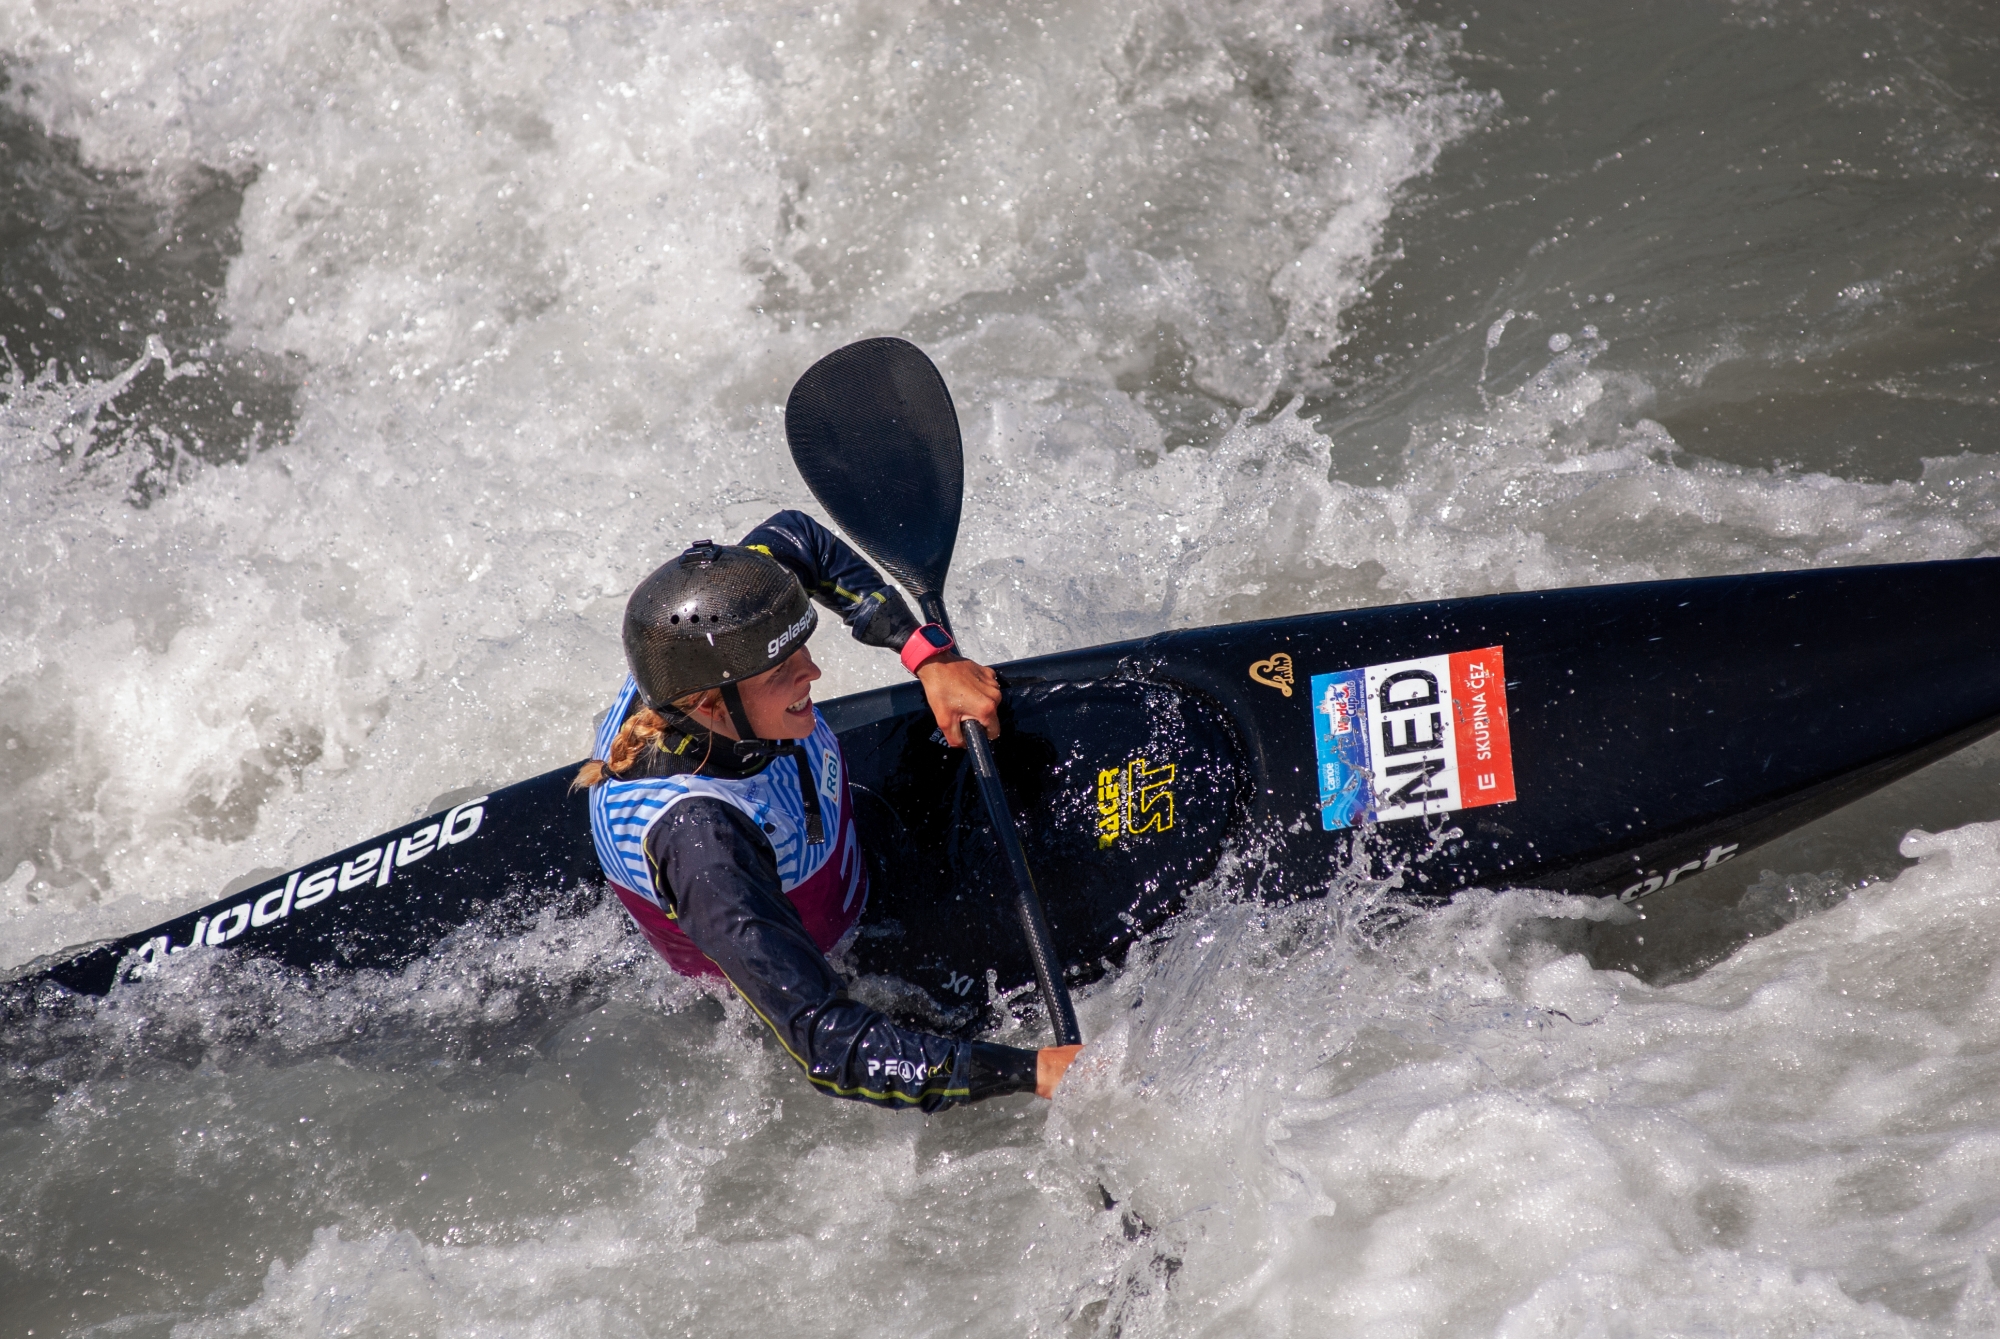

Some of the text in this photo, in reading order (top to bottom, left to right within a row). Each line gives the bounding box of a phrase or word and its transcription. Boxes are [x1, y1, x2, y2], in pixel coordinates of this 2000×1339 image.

[1347, 697, 1359, 717] Cup
[1379, 669, 1449, 807] NED
[1464, 662, 1492, 761] SKUPINA ČEZ
[827, 755, 839, 795] RGI
[1098, 767, 1120, 850] RACER
[1128, 758, 1175, 834] ST
[1326, 762, 1336, 791] canoe
[1599, 842, 1740, 904] ort
